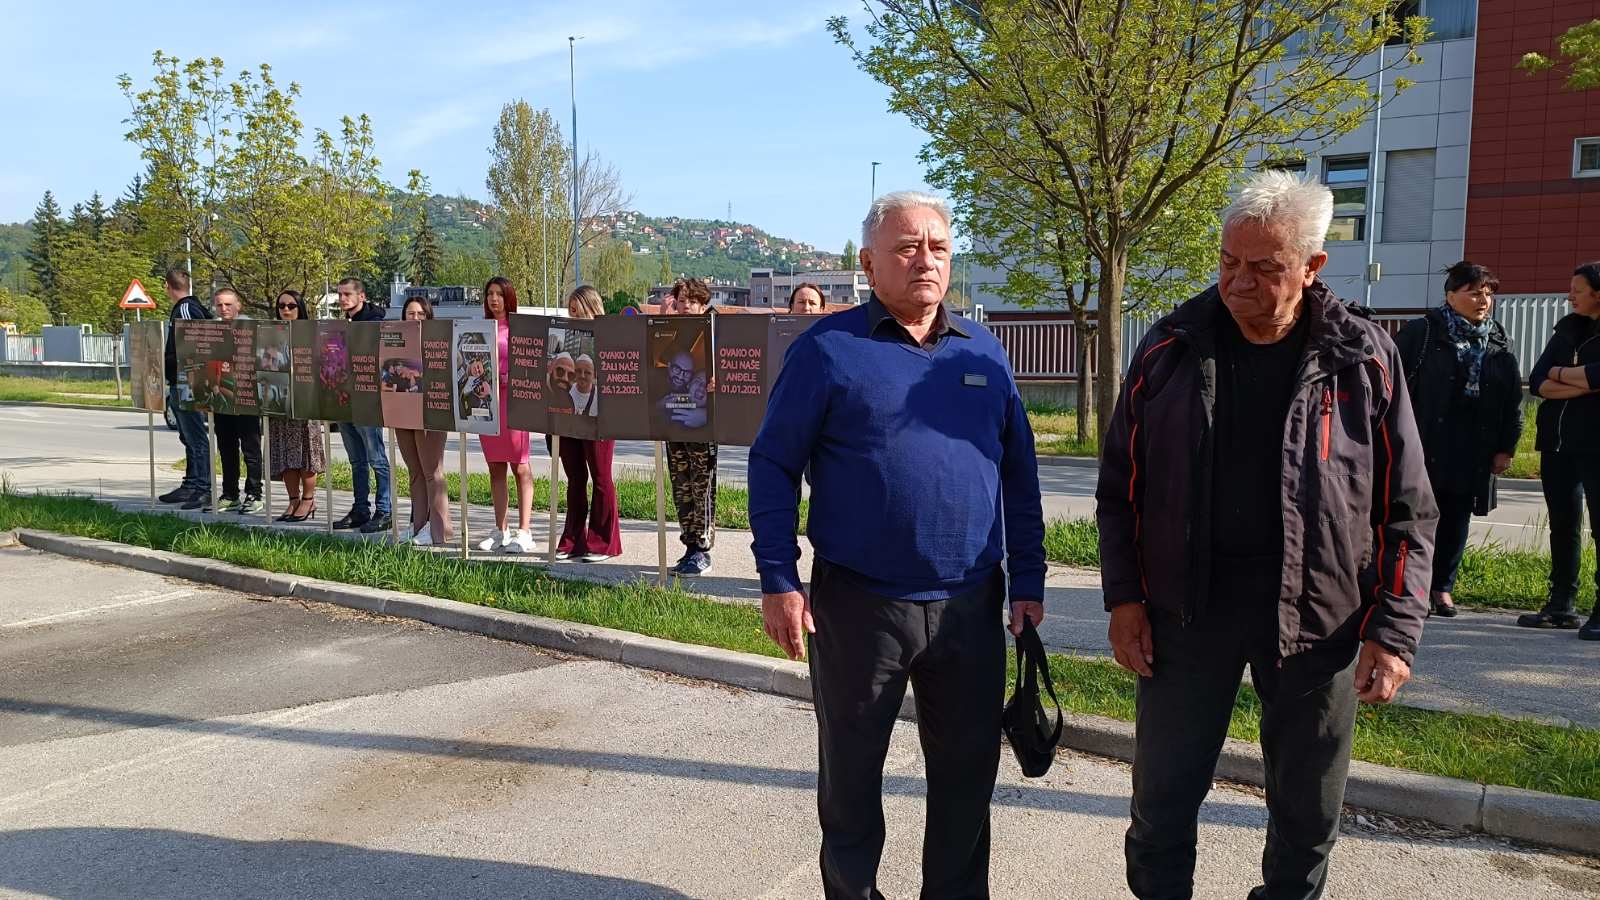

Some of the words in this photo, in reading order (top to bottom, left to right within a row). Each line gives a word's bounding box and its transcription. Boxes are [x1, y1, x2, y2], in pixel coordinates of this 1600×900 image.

[511, 335, 532, 346] OVAKO
[533, 338, 544, 347] ON
[512, 345, 525, 356] ŽALI
[526, 347, 542, 358] NAŠE
[599, 351, 626, 360] OVAKO
[626, 351, 640, 360] ON
[720, 348, 747, 358] OVAKO
[748, 348, 761, 358] ON
[601, 361, 618, 371] ŽALI
[618, 360, 639, 371] NAŠE
[721, 360, 738, 370] ŽALI
[739, 360, 761, 370] NAŠE
[606, 373, 636, 383] ANĐELE
[726, 373, 757, 382] ANĐELE
[721, 385, 761, 394] 01.01.2021
[512, 390, 541, 401] SUDSTVO
